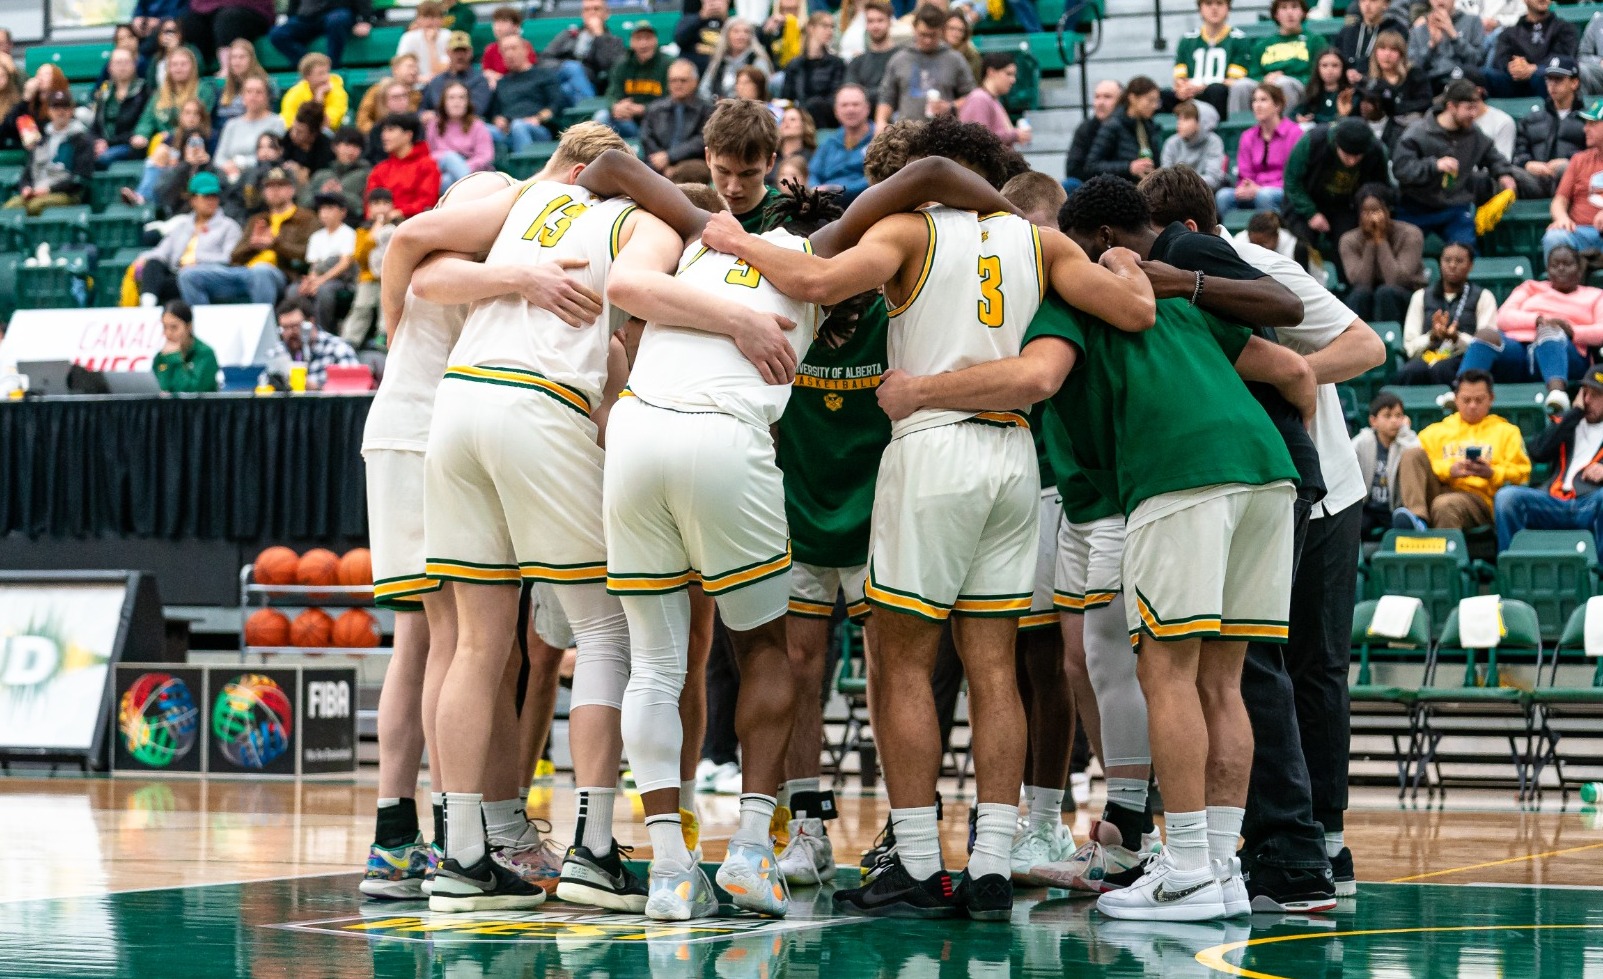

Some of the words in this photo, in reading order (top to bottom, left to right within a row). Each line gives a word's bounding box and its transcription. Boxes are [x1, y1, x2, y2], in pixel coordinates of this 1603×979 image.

[1192, 46, 1228, 86] 10
[521, 193, 588, 248] 13
[977, 254, 1005, 328] 3
[79, 320, 165, 350] CANAD
[794, 374, 877, 389] ASKETBALL
[796, 362, 830, 378] IVERSITY
[831, 367, 844, 379] OF
[845, 362, 882, 379] ALBERTA
[307, 680, 351, 719] FIBA
[340, 917, 736, 940] WEST
